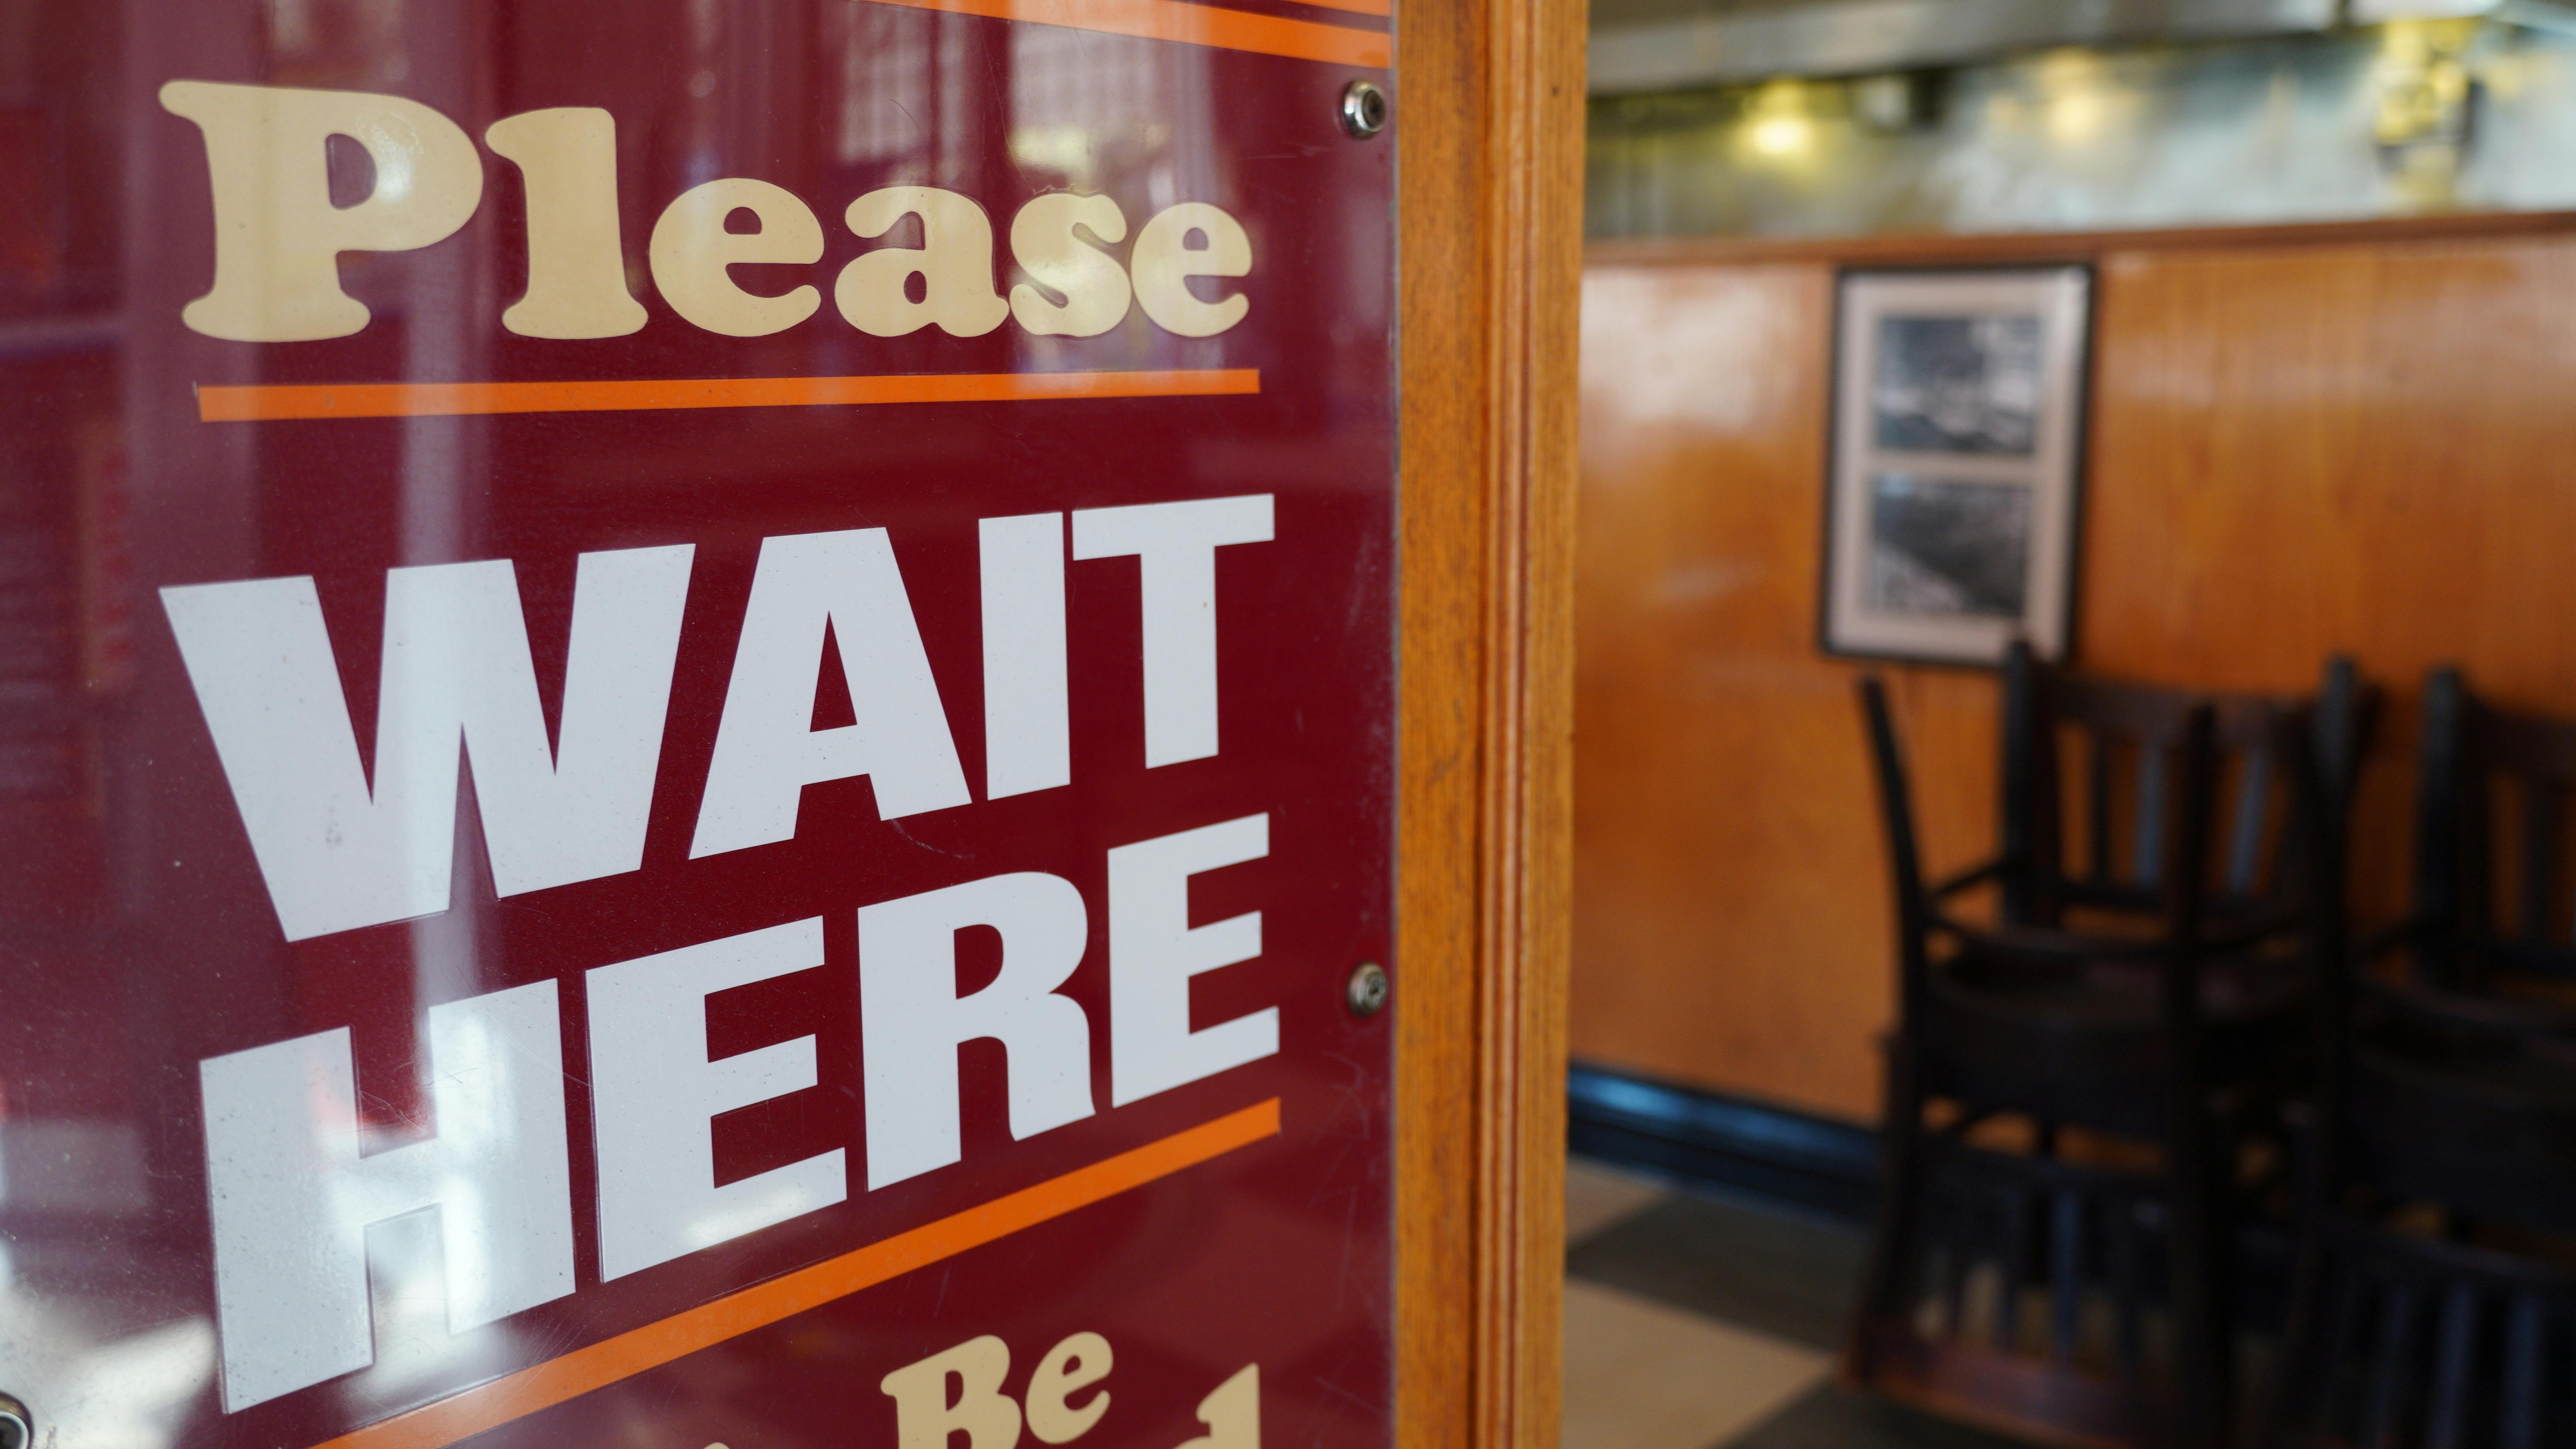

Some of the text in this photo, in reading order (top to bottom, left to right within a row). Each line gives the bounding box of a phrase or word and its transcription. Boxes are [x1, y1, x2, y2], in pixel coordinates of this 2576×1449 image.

[158, 80, 1253, 343] Please
[158, 493, 1275, 942] WAIT
[199, 812, 1280, 1414] HERE
[880, 1331, 1114, 1449] Be
